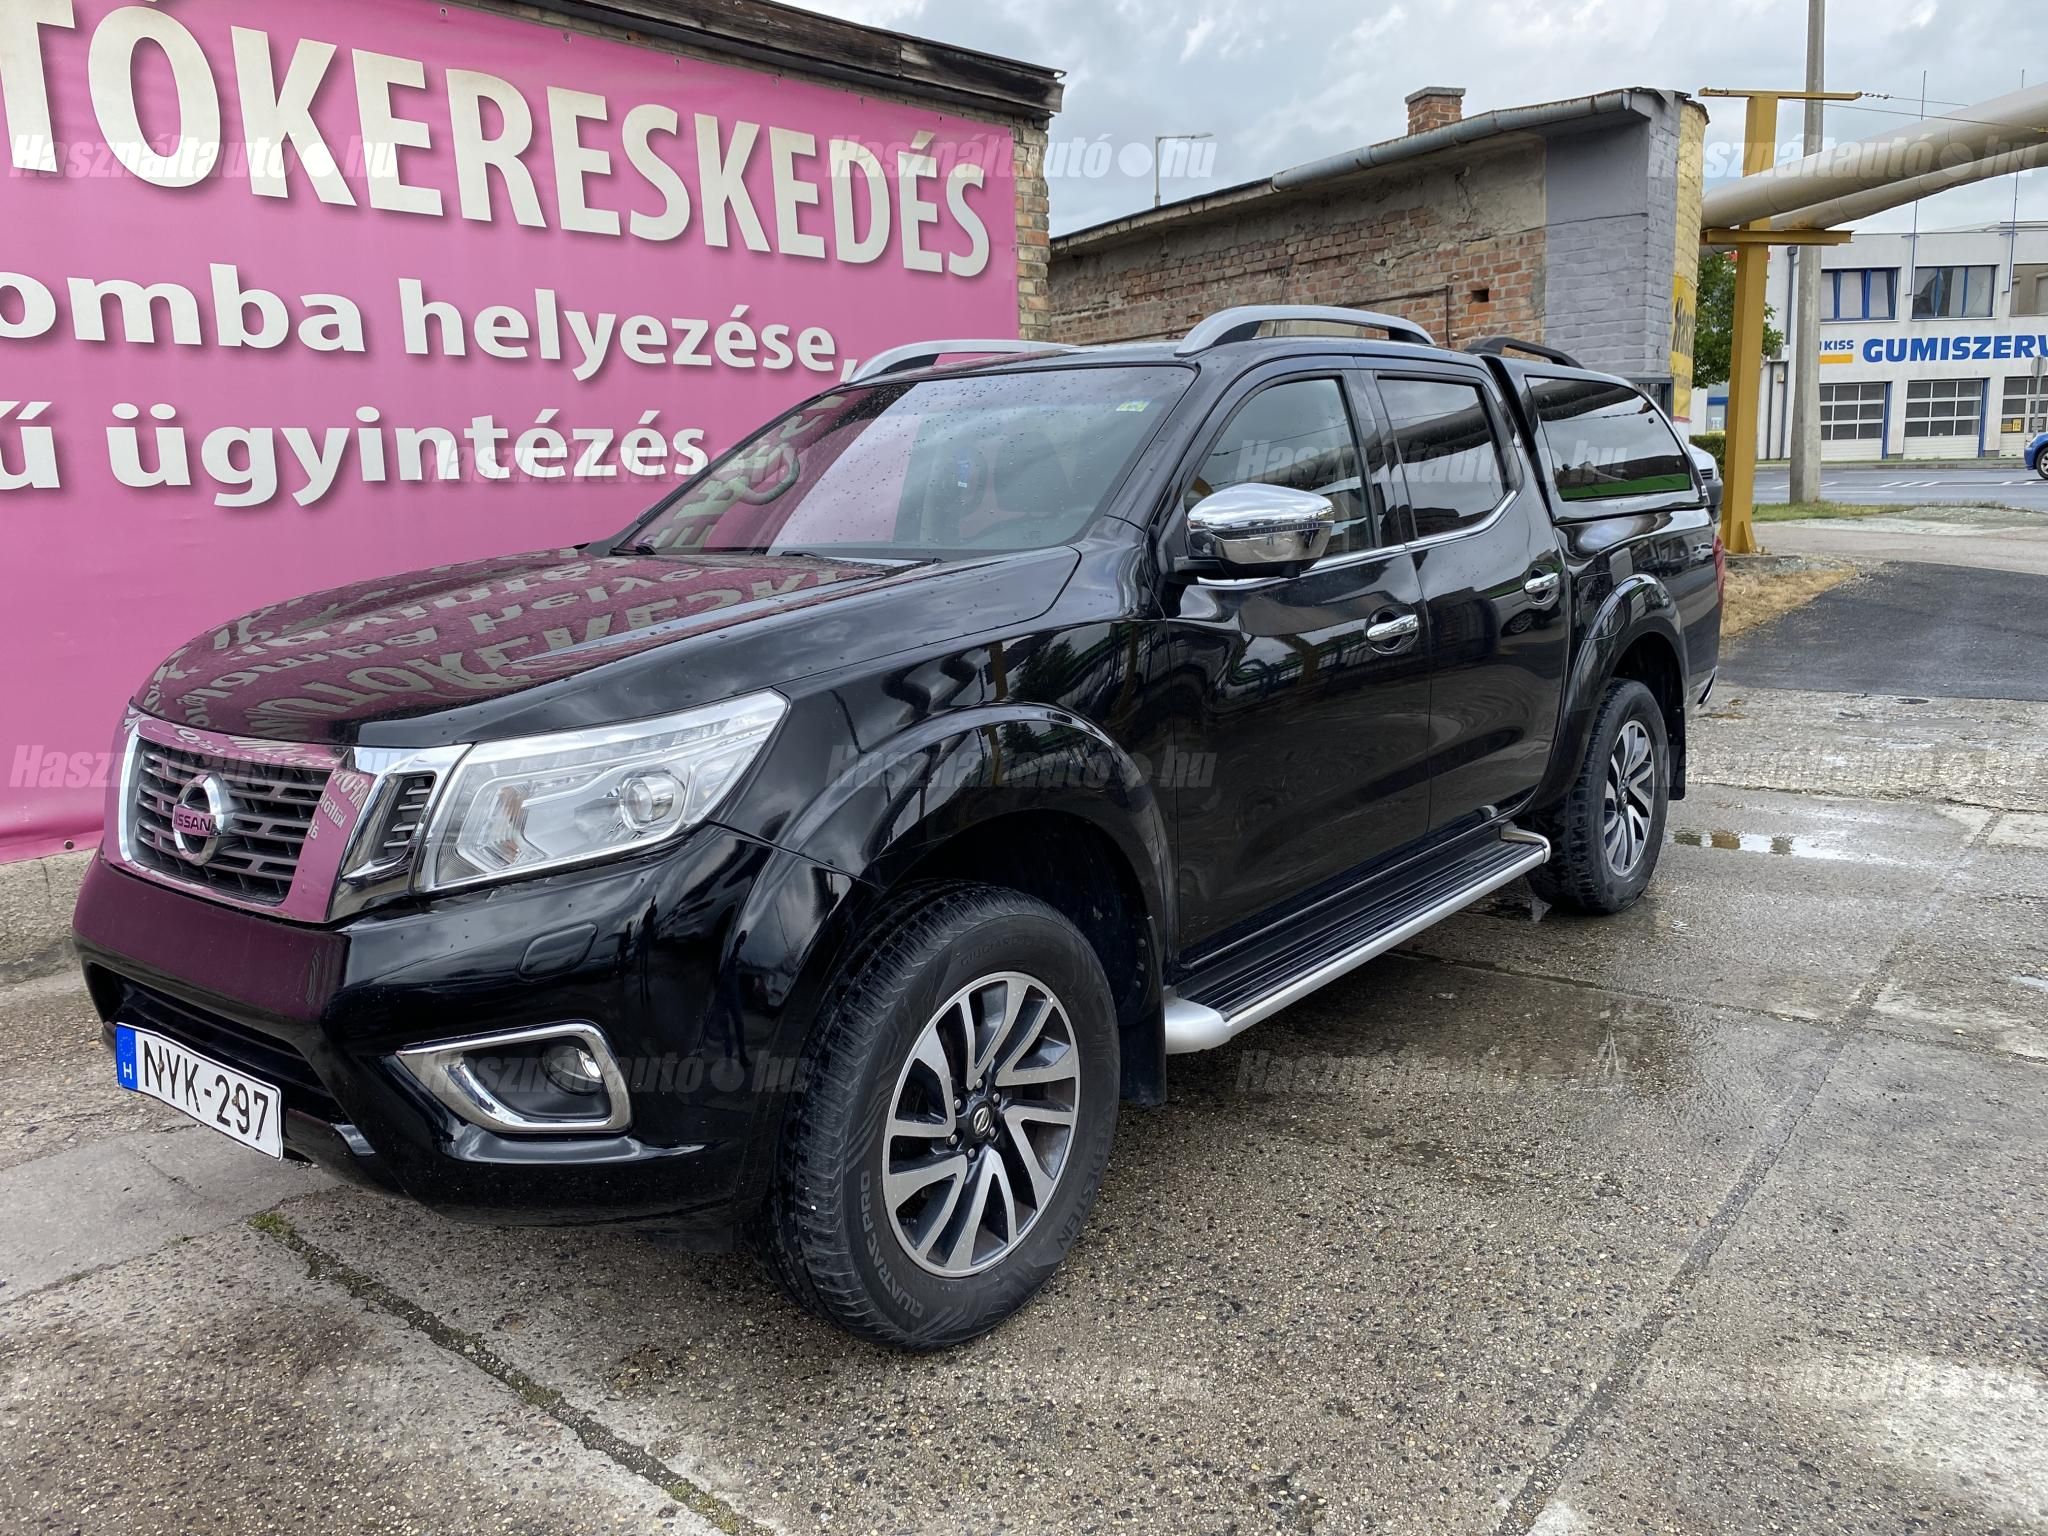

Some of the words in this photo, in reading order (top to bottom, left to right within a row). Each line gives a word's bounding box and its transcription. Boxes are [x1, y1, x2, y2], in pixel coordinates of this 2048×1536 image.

[0, 262, 366, 352] omba
[398, 277, 859, 383] helyezése,
[1824, 339, 1854, 351] KISS
[106, 402, 710, 507] ügyintézés
[173, 811, 212, 832] ISSAN
[122, 1062, 133, 1080] H
[143, 1040, 269, 1141] NYK-297
[860, 1169, 874, 1233] PRO
[866, 1230, 925, 1319] QUATRAC
